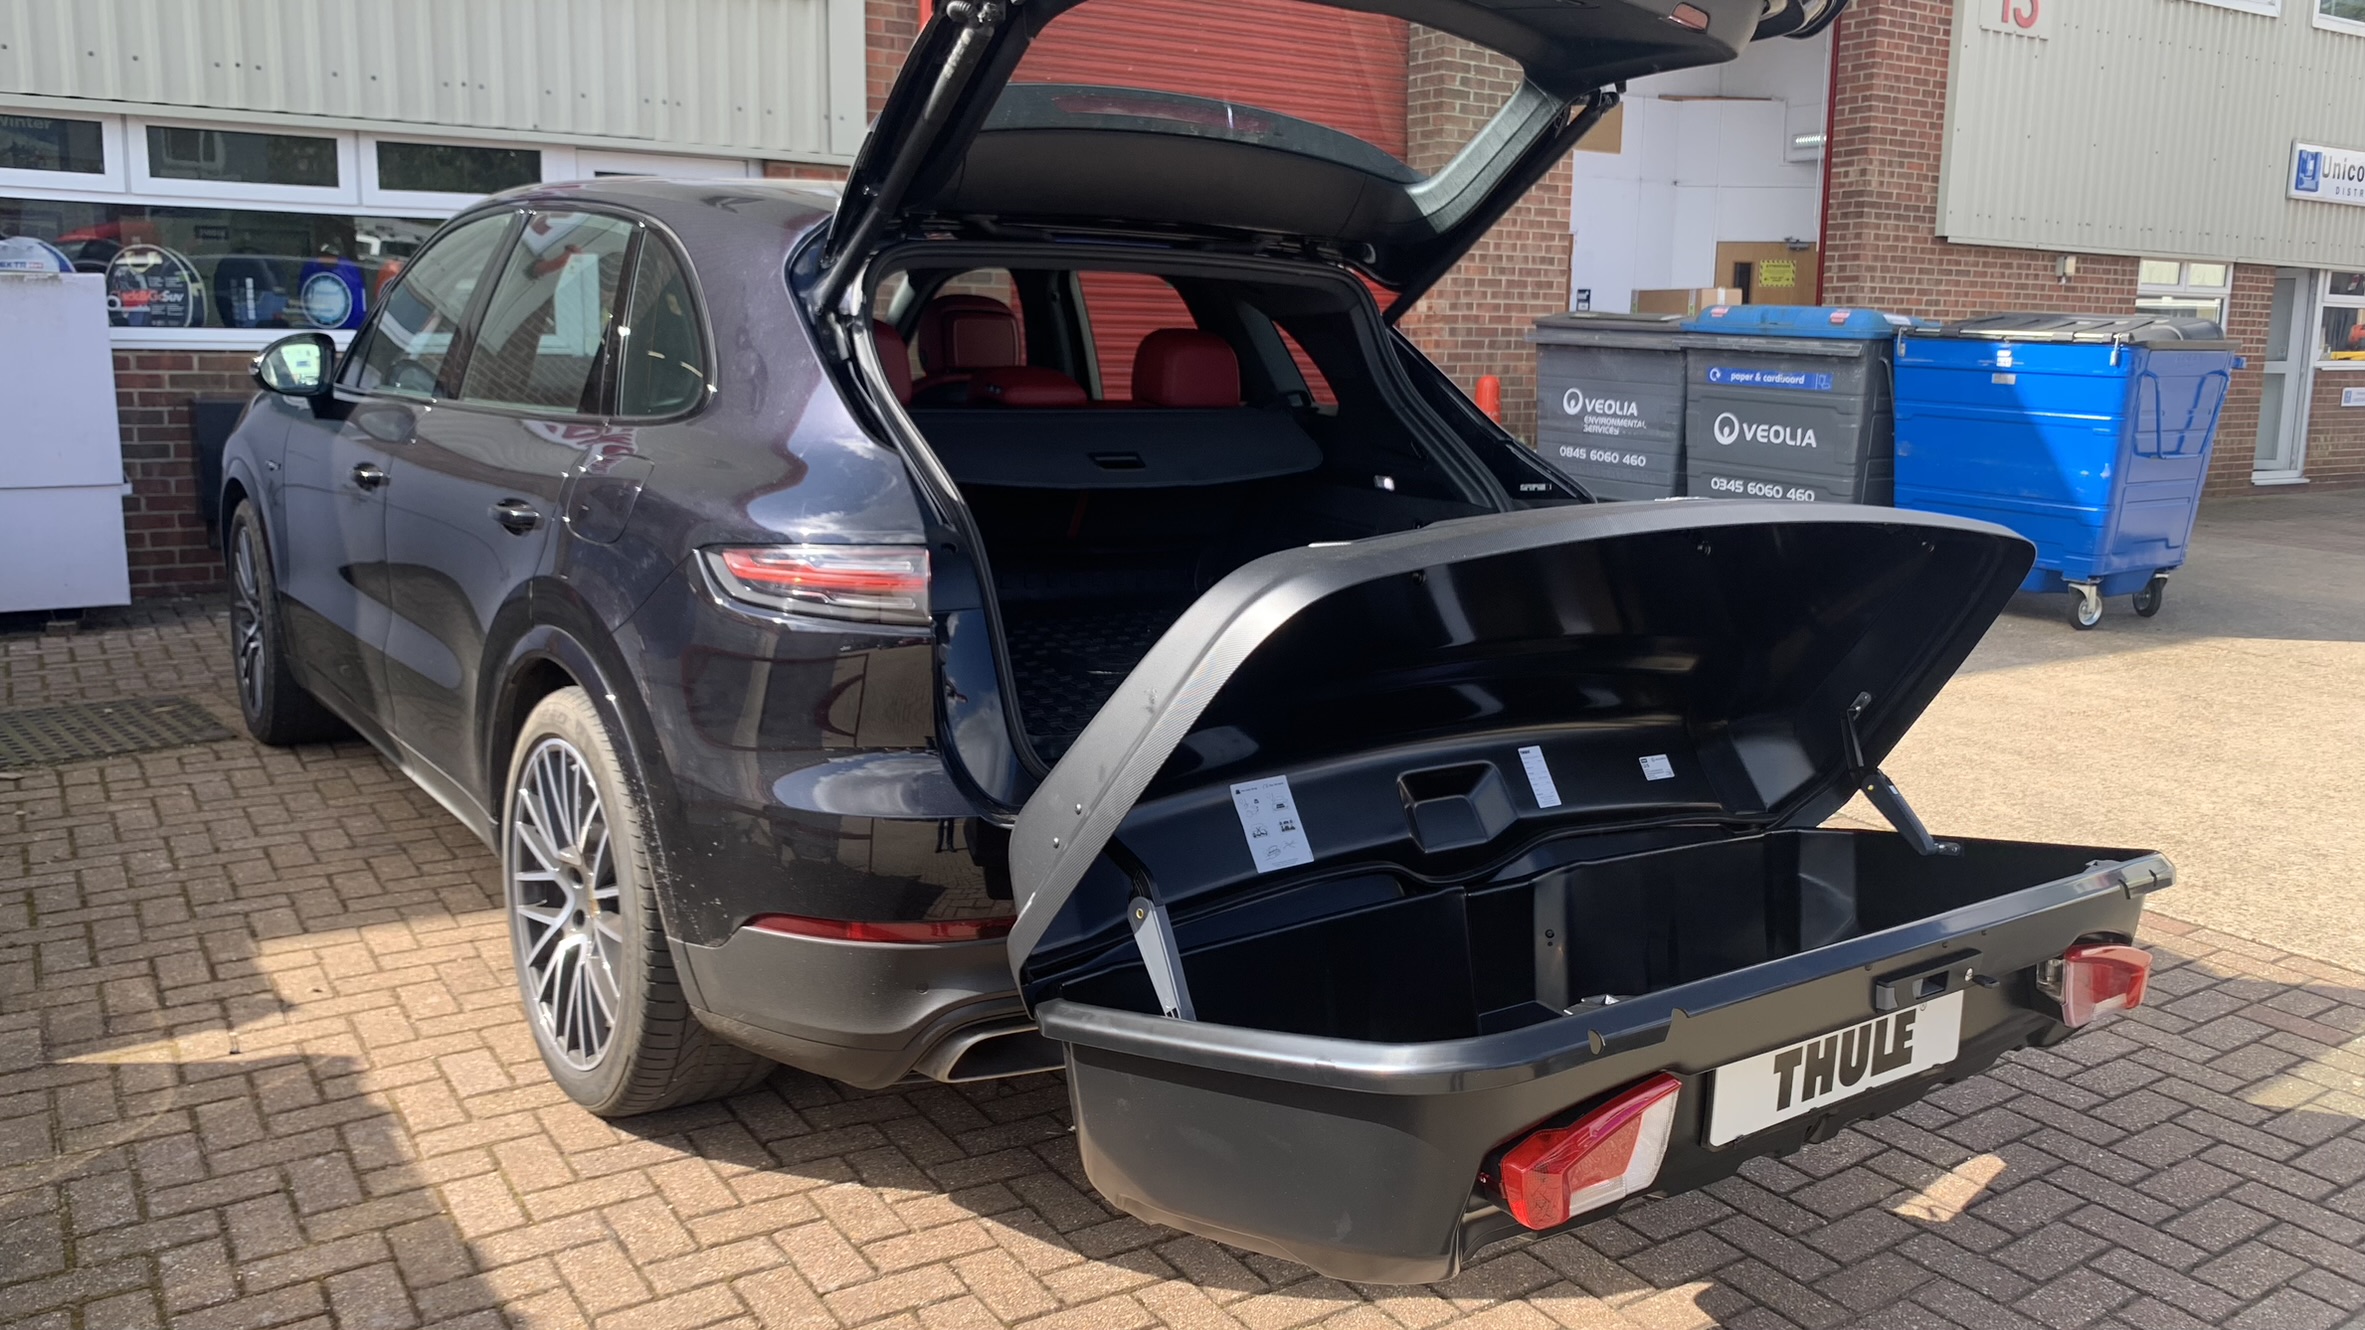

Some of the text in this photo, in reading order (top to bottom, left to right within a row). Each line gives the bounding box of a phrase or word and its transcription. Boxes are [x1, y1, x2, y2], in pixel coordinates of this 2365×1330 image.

[2322, 155, 2365, 182] Unico
[1730, 372, 1753, 382] paper
[1754, 372, 1761, 382] &
[1585, 398, 1638, 417] VEOLIA
[1583, 415, 1646, 429] ENVIRONMENTAL
[1742, 422, 1817, 448] VEOLIA
[1559, 445, 1646, 467] 0845 6060 460
[1710, 477, 1815, 502] 0345 6060 460
[1773, 1007, 1917, 1112] THULE
